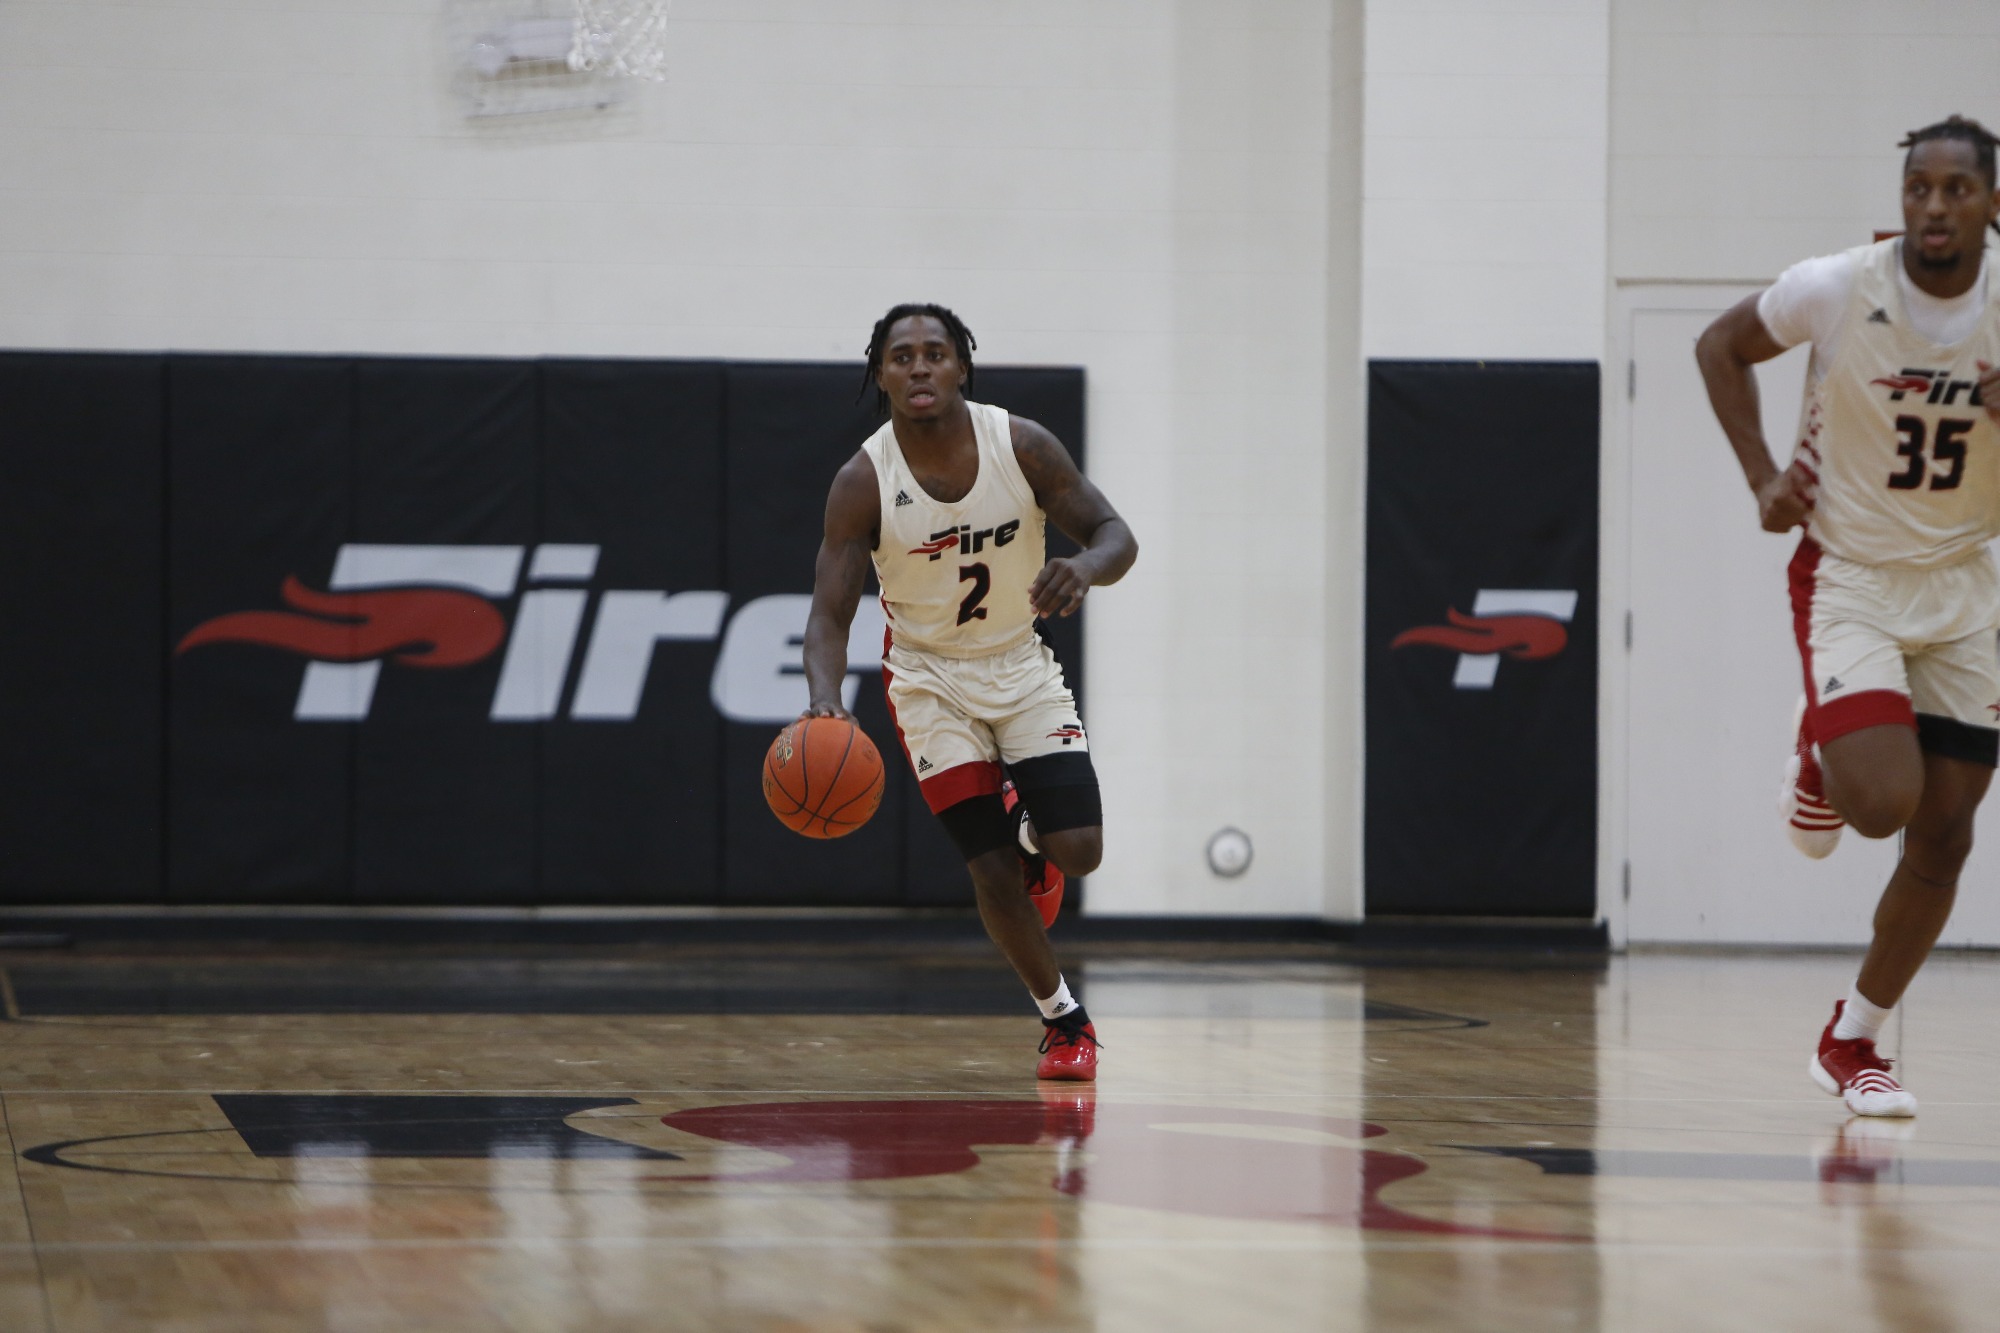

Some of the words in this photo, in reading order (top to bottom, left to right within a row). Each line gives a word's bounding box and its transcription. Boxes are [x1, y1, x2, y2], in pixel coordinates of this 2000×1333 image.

[1887, 414, 1975, 491] 35
[908, 518, 1020, 562] Fire
[956, 561, 991, 627] 2
[176, 544, 887, 722] Fire
